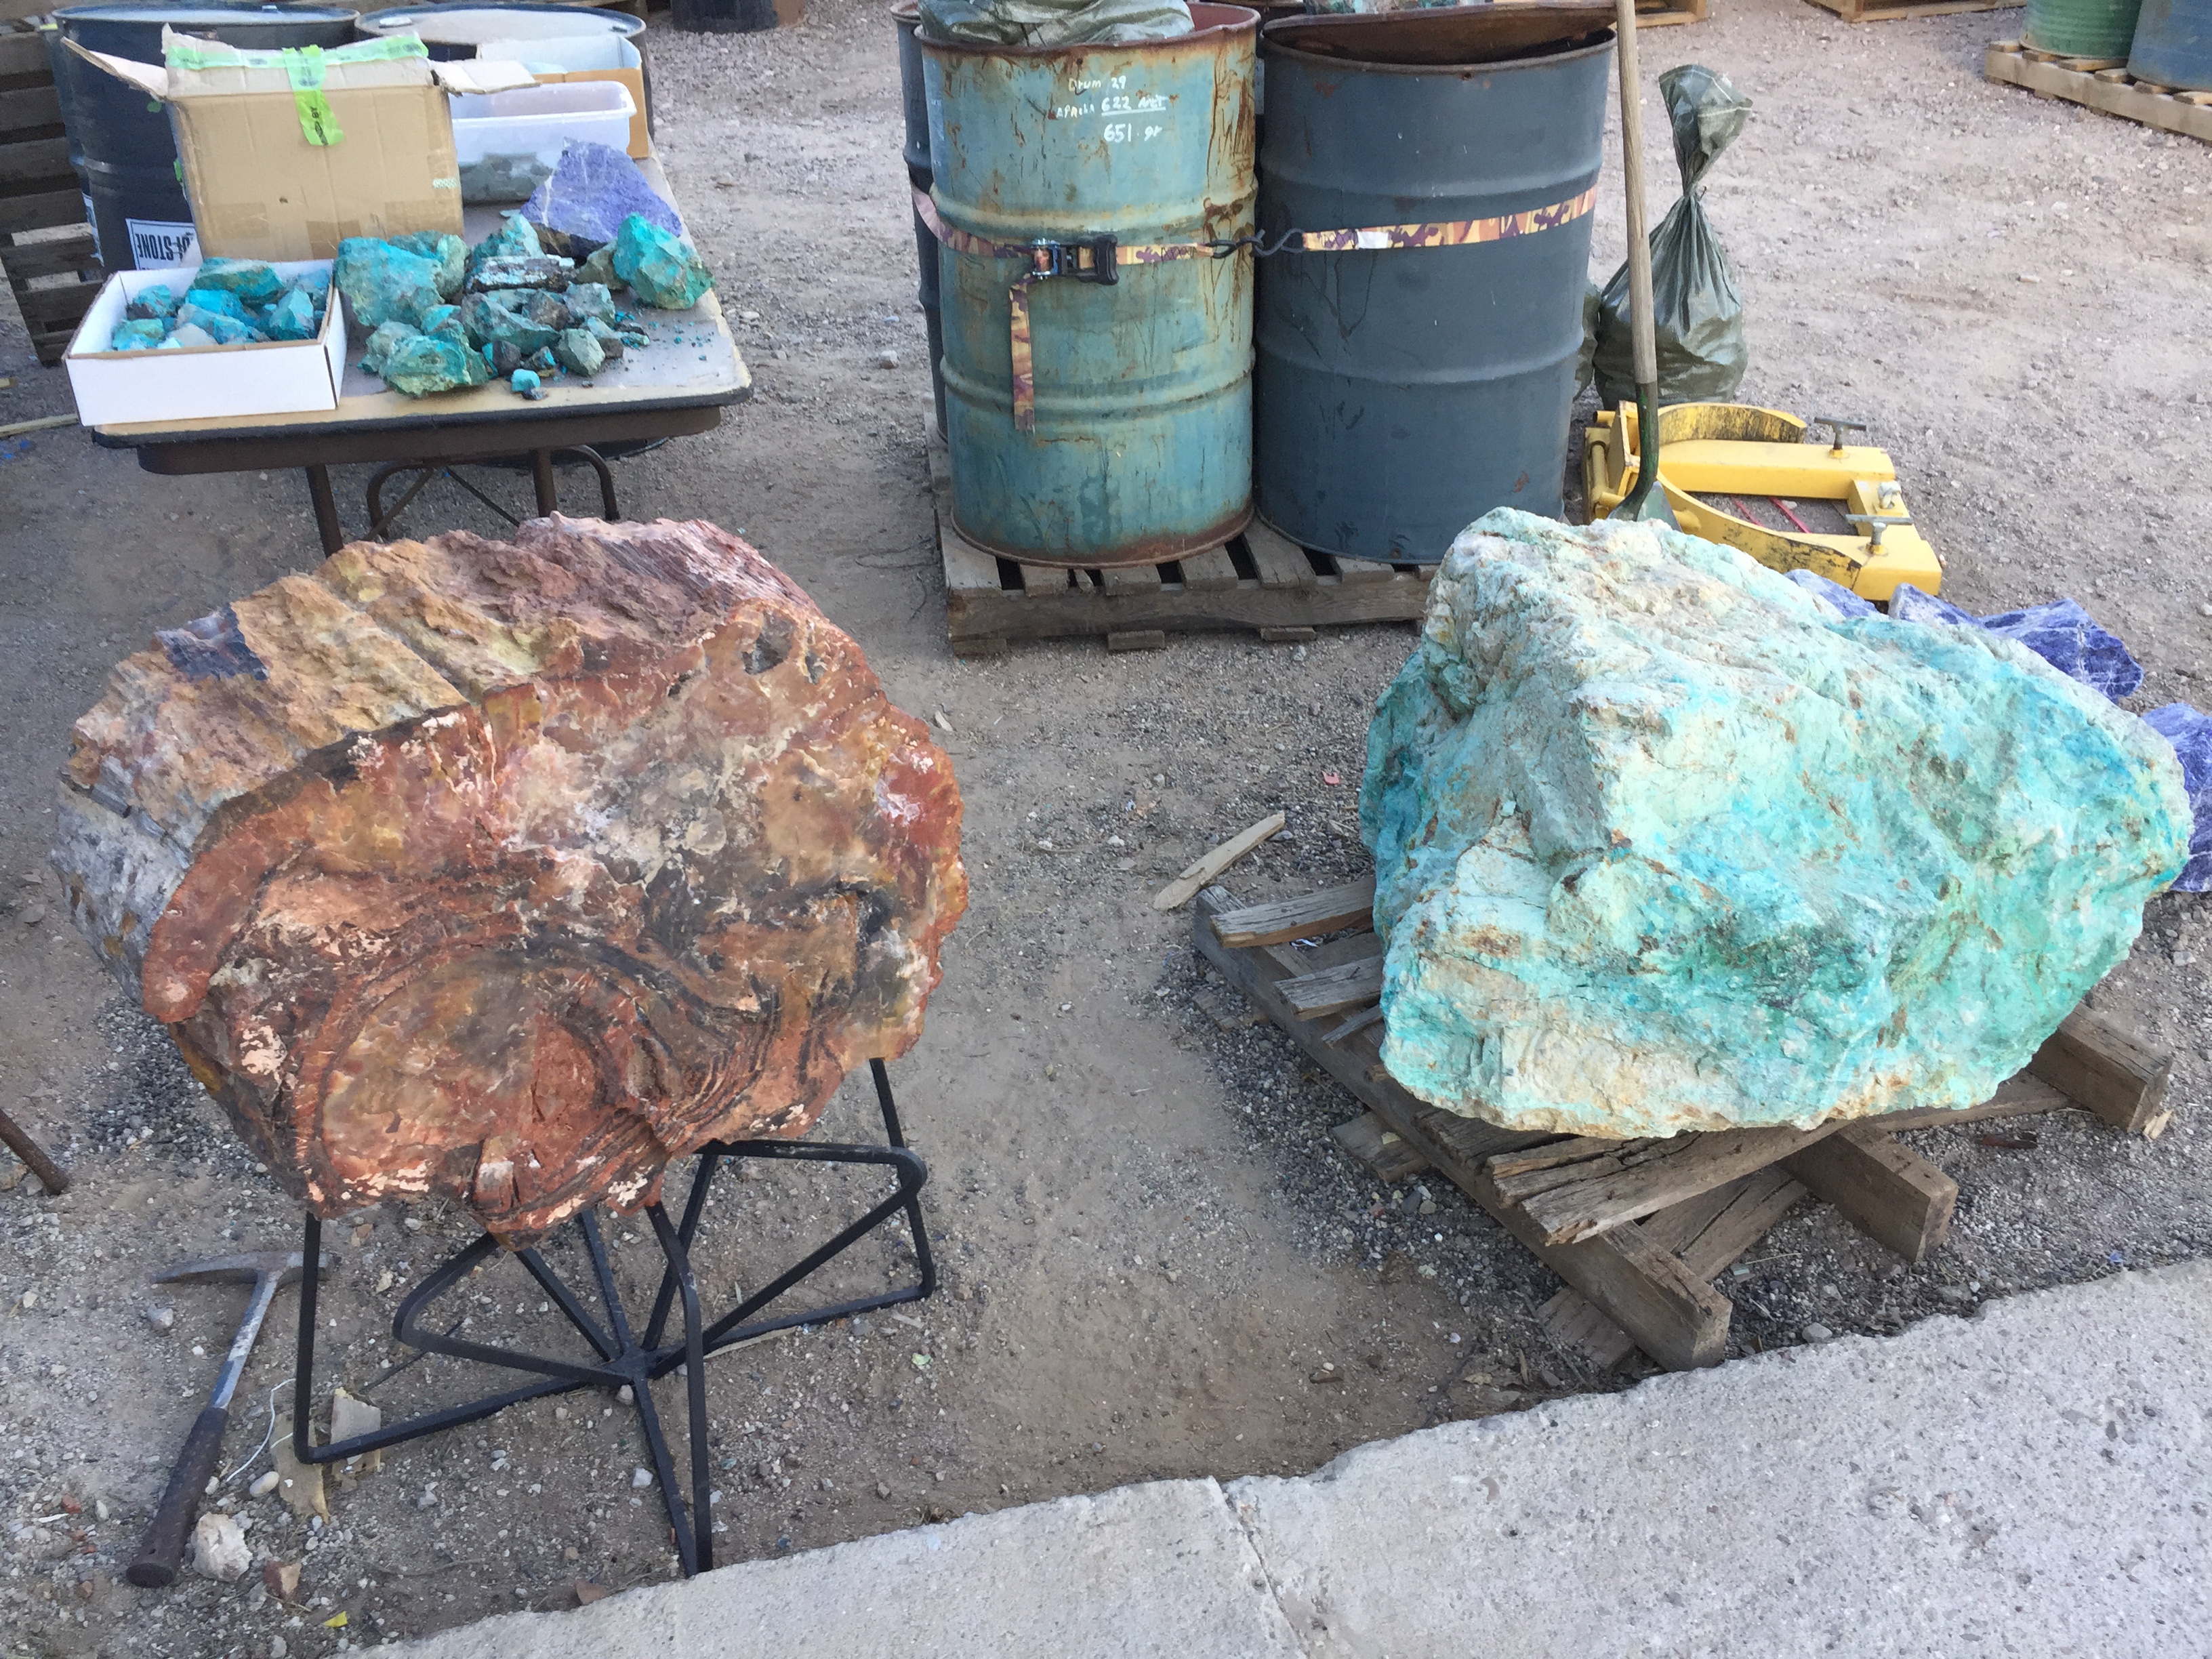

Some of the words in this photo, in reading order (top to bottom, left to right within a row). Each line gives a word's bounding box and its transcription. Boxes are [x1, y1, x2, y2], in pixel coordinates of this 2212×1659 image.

[1111, 75, 1126, 89] 29
[1101, 96, 1132, 112] 622
[135, 232, 174, 261] STONE
